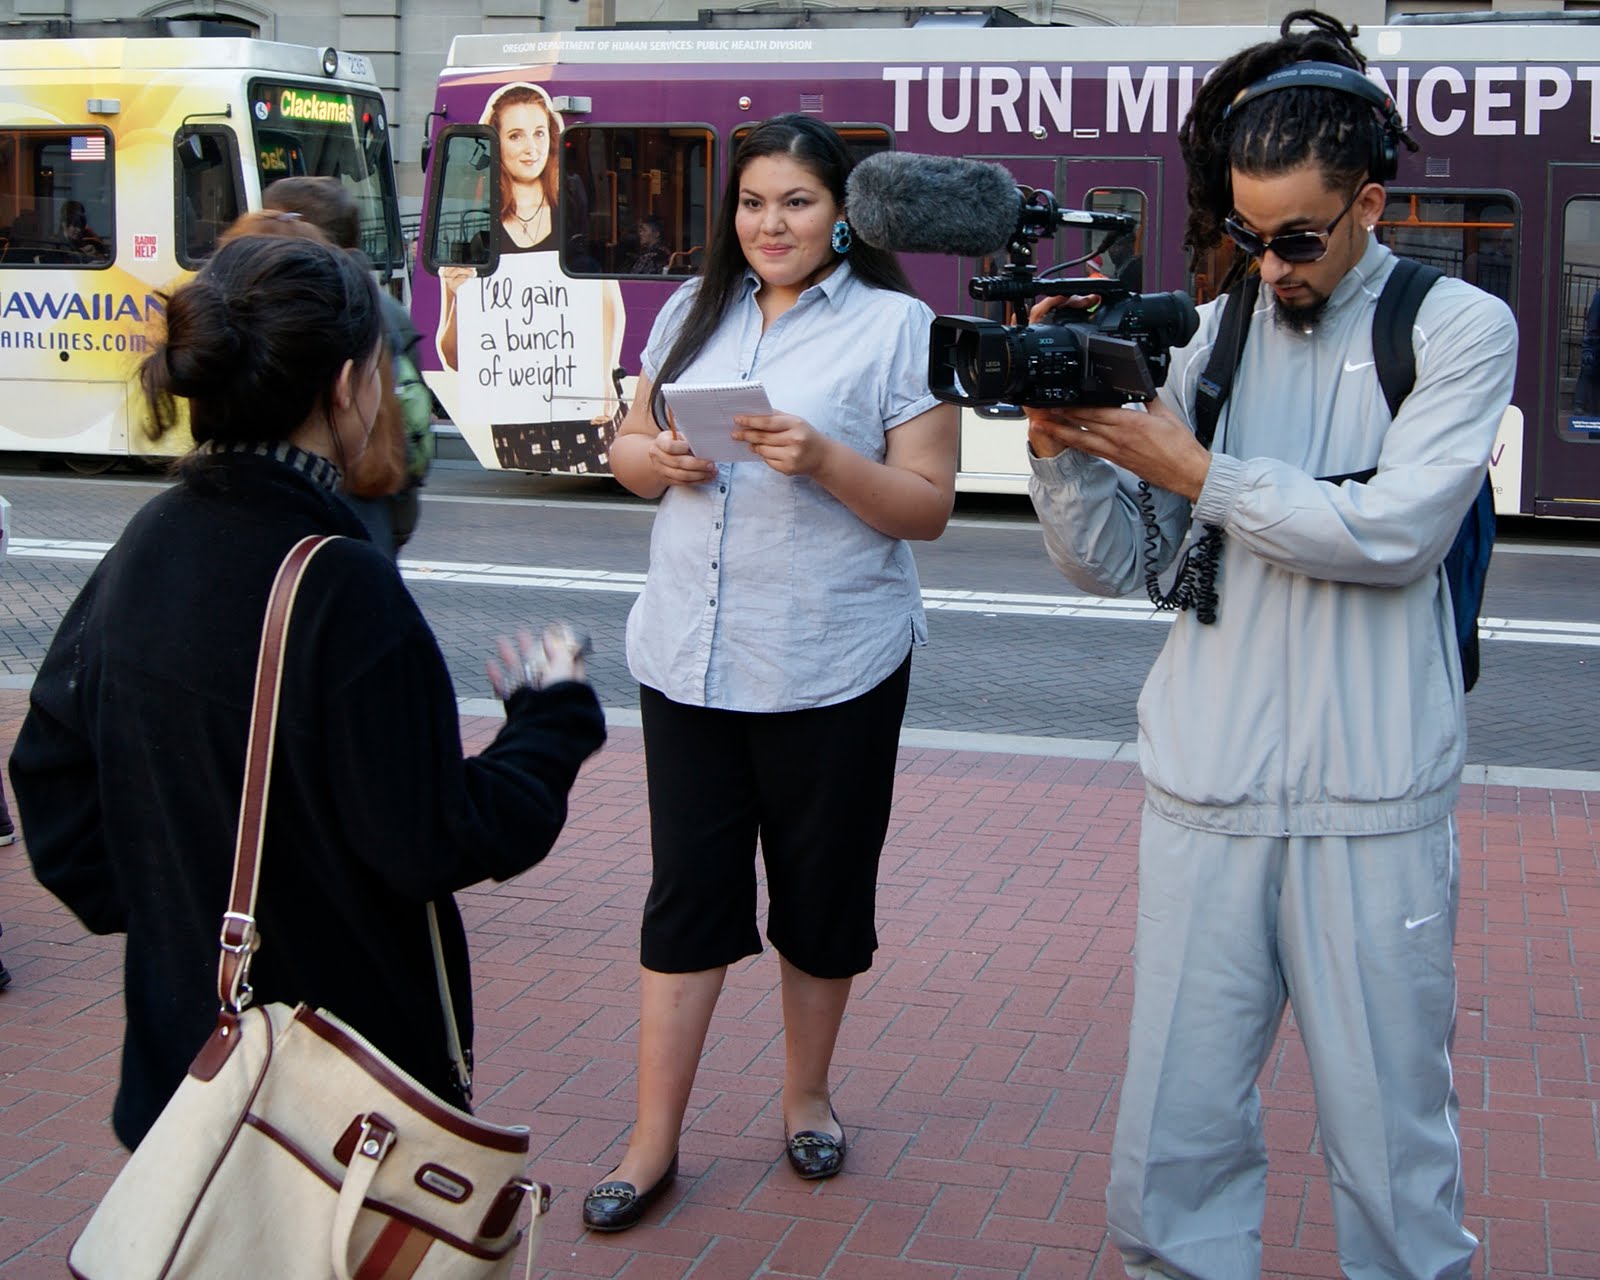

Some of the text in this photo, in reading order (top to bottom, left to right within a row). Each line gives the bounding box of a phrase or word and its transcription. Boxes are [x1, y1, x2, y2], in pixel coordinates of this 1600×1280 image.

[502, 40, 813, 54] OREGON DEPARTMENT OF HUMAN SERVICES: PUBLIC HEALTH DIVISION
[347, 57, 367, 75] 235
[280, 90, 355, 124] Clackamas
[882, 66, 1073, 133] TURN
[134, 245, 157, 258] HELP
[481, 277, 569, 325] I'll gain
[480, 313, 574, 351] a bunch
[479, 354, 577, 403] of weight
